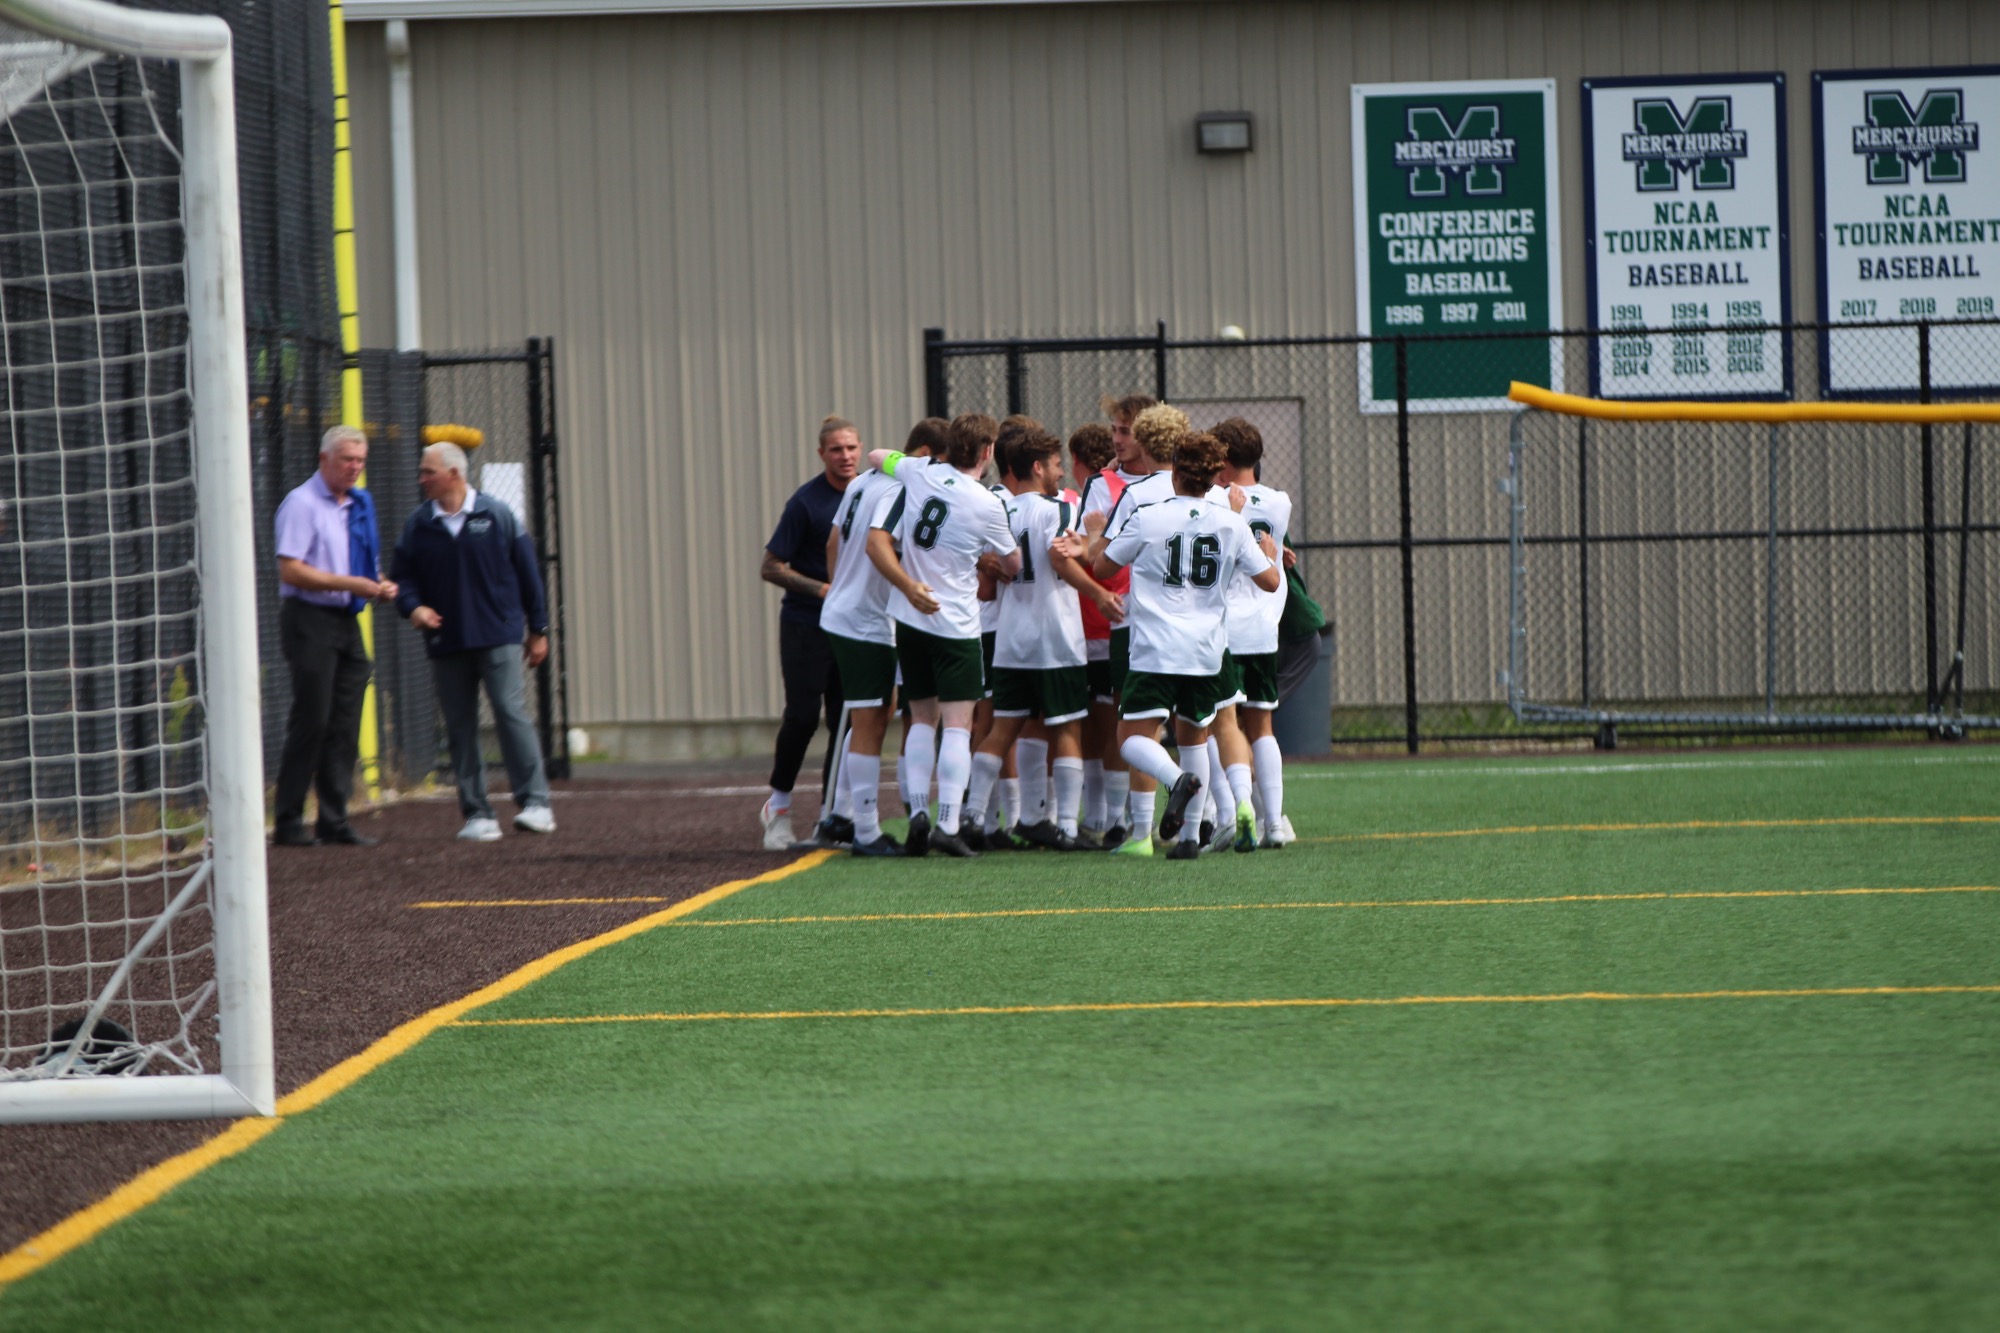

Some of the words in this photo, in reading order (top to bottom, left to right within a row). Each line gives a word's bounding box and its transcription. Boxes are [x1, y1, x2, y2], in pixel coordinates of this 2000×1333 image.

[1624, 132, 1745, 153] MERCYHURST
[1855, 125, 1976, 146] MERCYHURST
[1395, 138, 1515, 160] MERCYHURST
[1654, 200, 1719, 225] NCAA
[1884, 193, 1950, 218] NCAA
[1379, 208, 1535, 237] CONFERENCE
[1834, 219, 2000, 246] TOURNAMENT
[1388, 236, 1528, 264] CHAMPIONS
[1603, 226, 1771, 253] TOURNAMENT
[1628, 262, 1749, 288] BASEBALL
[1858, 255, 1980, 280] BASEBALL
[1405, 271, 1513, 295] BASEBALL
[1386, 305, 1424, 325] 1996
[1440, 303, 1478, 322] 1997
[1493, 302, 1526, 321] 2011
[1611, 304, 1642, 321] 1991
[1671, 302, 1709, 319] 1994
[1841, 300, 1877, 317] 2017
[1899, 298, 1937, 315] 2018
[1956, 296, 1994, 314] 2019
[1613, 359, 1649, 376] 2014
[1673, 357, 1710, 375] 2015
[913, 495, 950, 551] 8
[1163, 532, 1221, 589] 16
